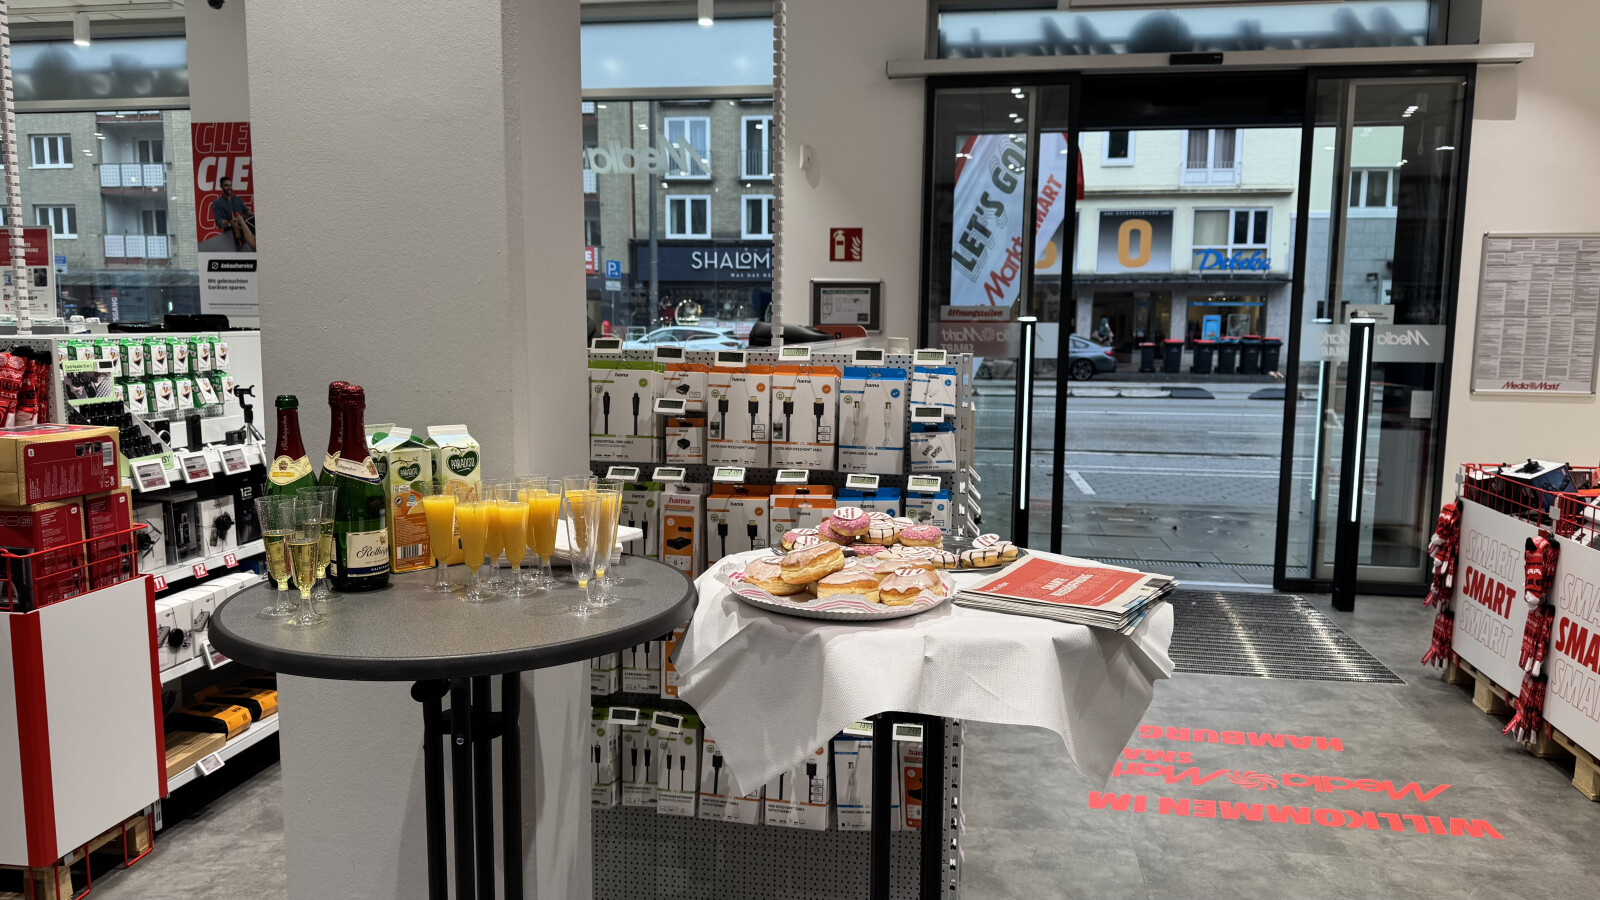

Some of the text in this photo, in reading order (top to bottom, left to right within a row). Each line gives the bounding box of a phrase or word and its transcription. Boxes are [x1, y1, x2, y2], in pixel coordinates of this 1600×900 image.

[197, 156, 252, 192] CLE
[1035, 173, 1063, 235] MART
[951, 191, 1004, 273] LET'S
[608, 261, 617, 276] P
[947, 308, 1003, 319] Öffnungszeiten
[1502, 381, 1561, 390] Media Markt
[240, 486, 253, 497] 12
[668, 496, 691, 505] hama
[195, 563, 205, 576] 12
[226, 554, 236, 566] 13
[1465, 529, 1521, 582] SMART
[154, 576, 165, 590] 11
[1462, 565, 1517, 620] SMART
[1459, 601, 1513, 659] SMART
[1139, 724, 1345, 752] HAMBURG
[1282, 772, 1452, 802] Media
[1088, 791, 1505, 839] WILLKOMMEN IM
